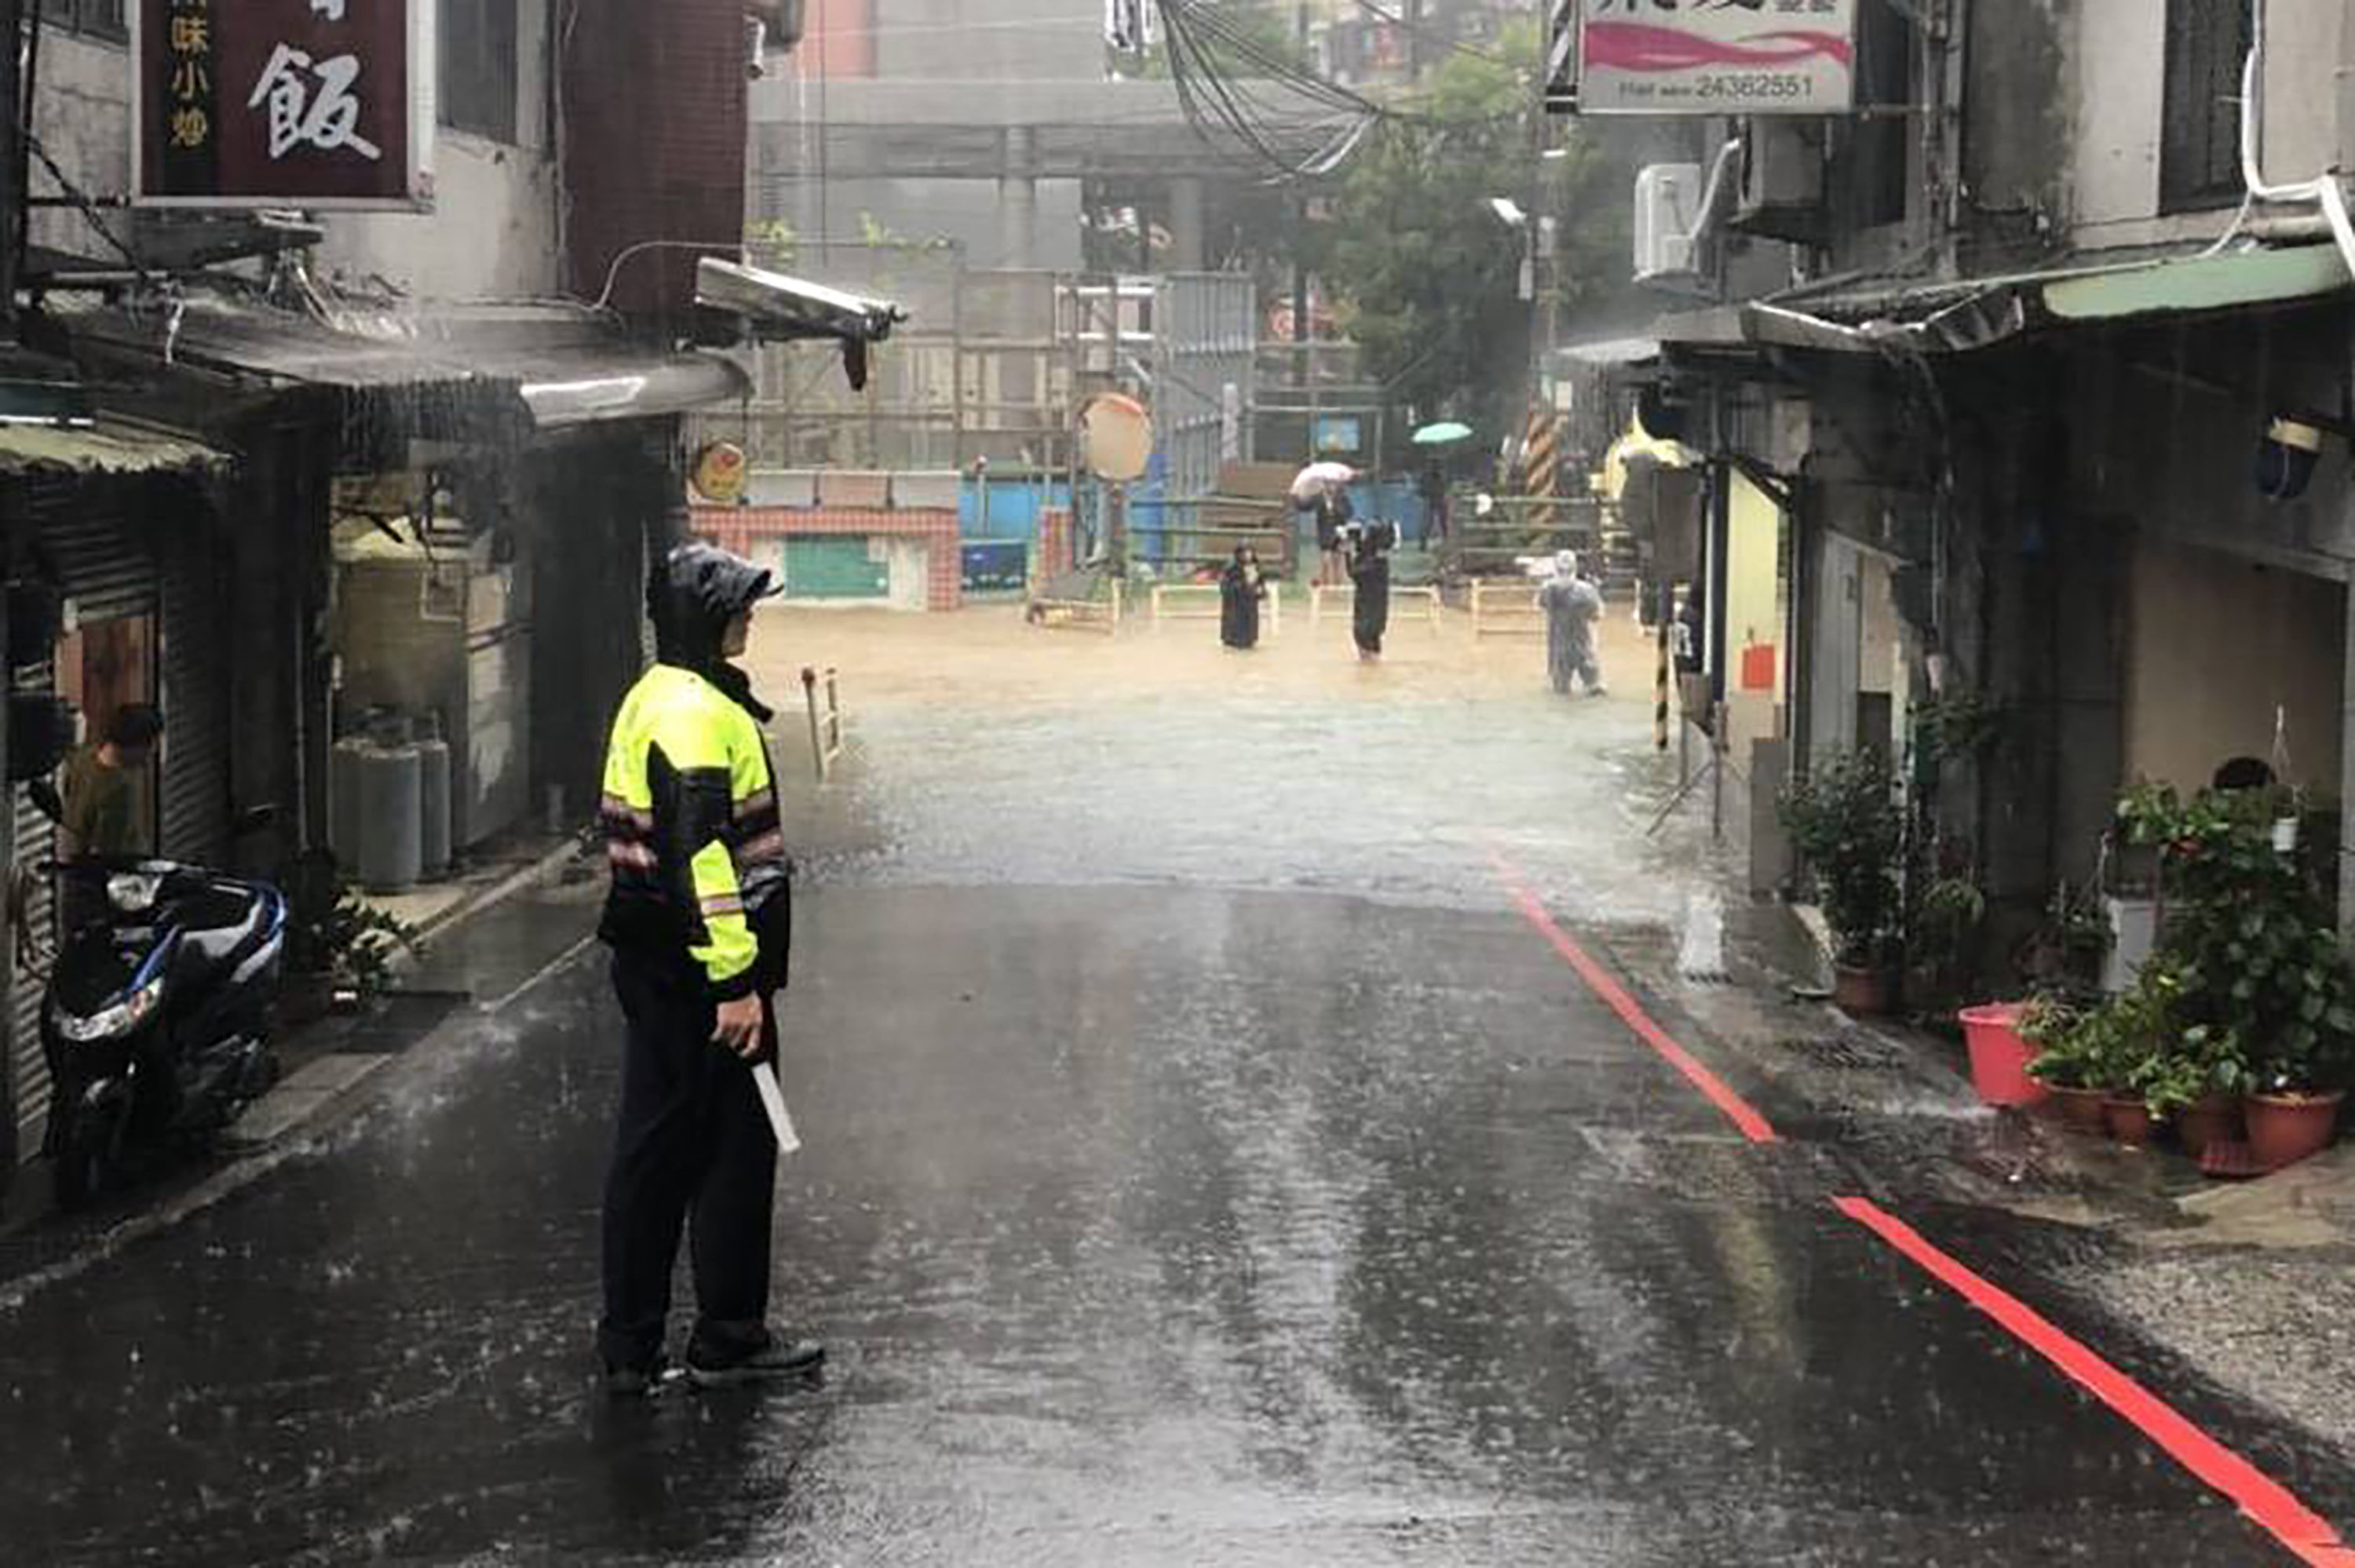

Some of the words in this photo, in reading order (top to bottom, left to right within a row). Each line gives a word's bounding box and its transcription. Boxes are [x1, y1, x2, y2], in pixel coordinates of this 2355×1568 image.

[170, 0, 209, 148] 味小炒
[246, 0, 382, 159] 飯
